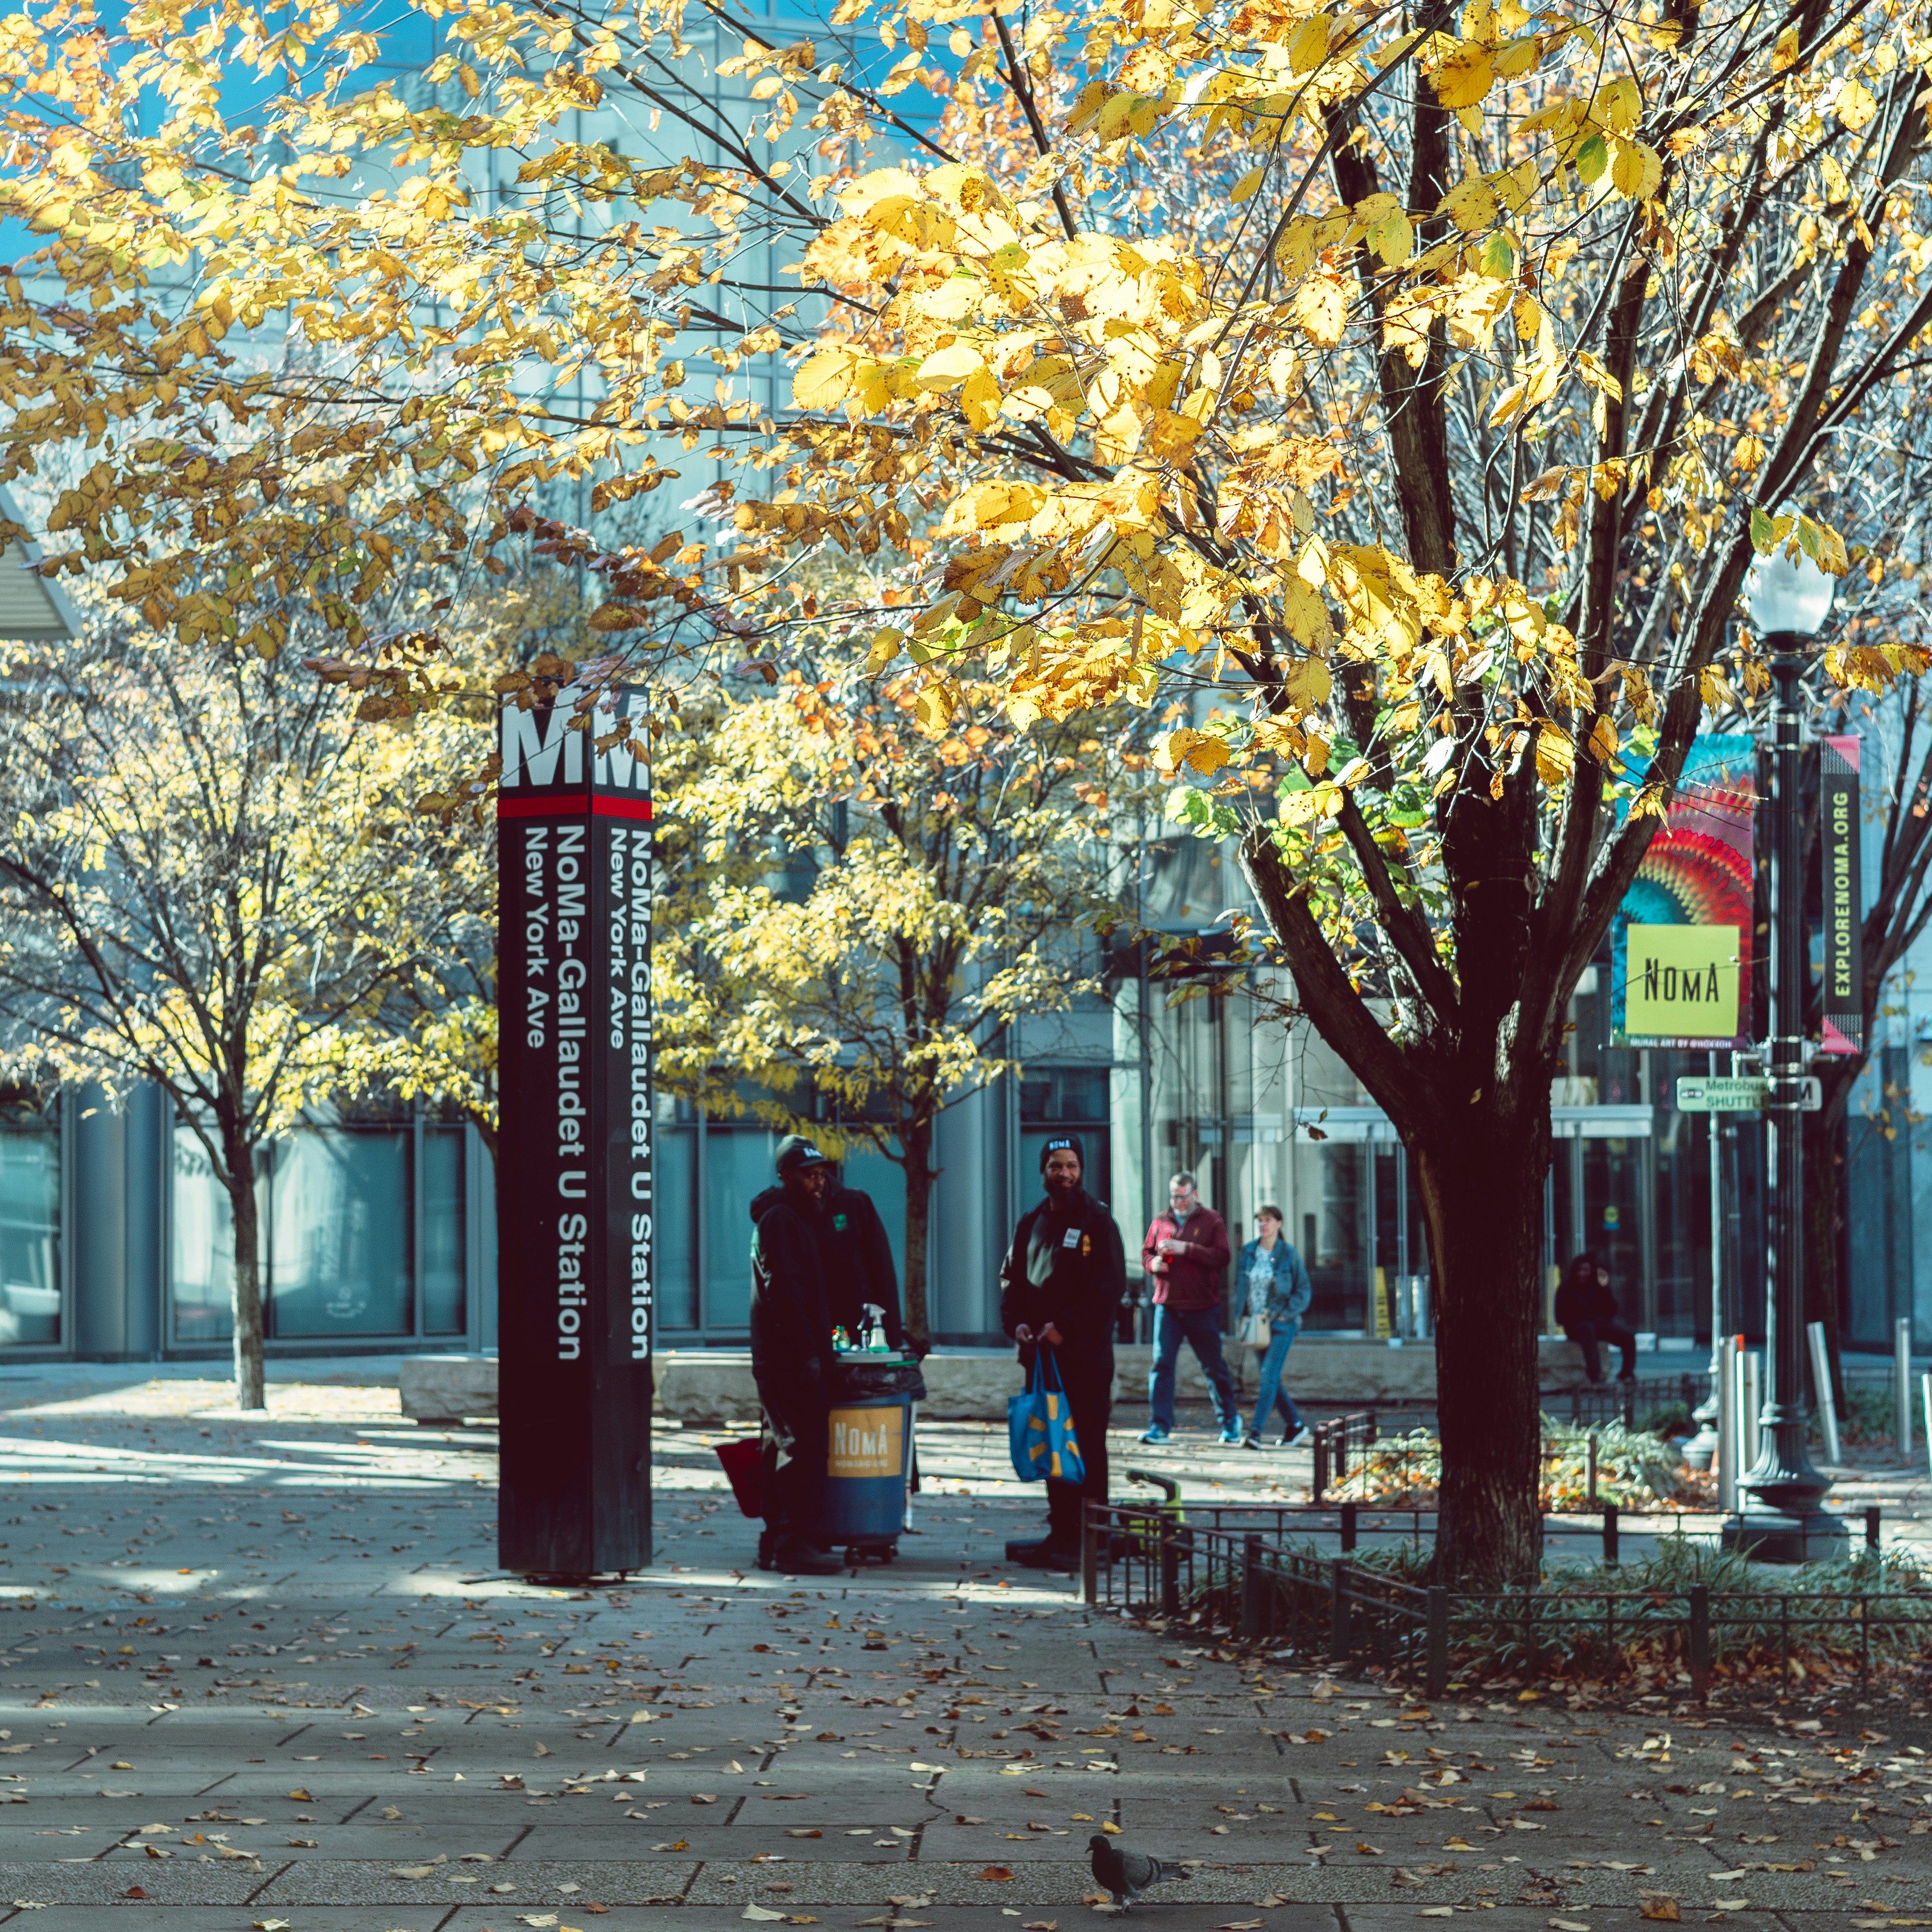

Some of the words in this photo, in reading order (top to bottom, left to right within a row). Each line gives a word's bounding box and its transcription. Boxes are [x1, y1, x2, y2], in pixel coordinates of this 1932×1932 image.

[501, 687, 583, 787] M
[593, 690, 649, 790] M
[525, 827, 548, 897] New
[610, 828, 628, 899] New
[1833, 791, 1851, 997] EXPLORENOMA.ORG
[526, 902, 550, 977] York
[610, 904, 627, 977] York
[527, 986, 550, 1048] Ave
[556, 825, 587, 1157] NoMa-Gallaudet
[610, 986, 627, 1050] Ave
[631, 829, 651, 1160] NoMa-Gallaudet
[558, 1170, 587, 1198] U
[631, 1171, 651, 1199] U
[558, 1213, 587, 1360] Station
[631, 1213, 652, 1359] Station
